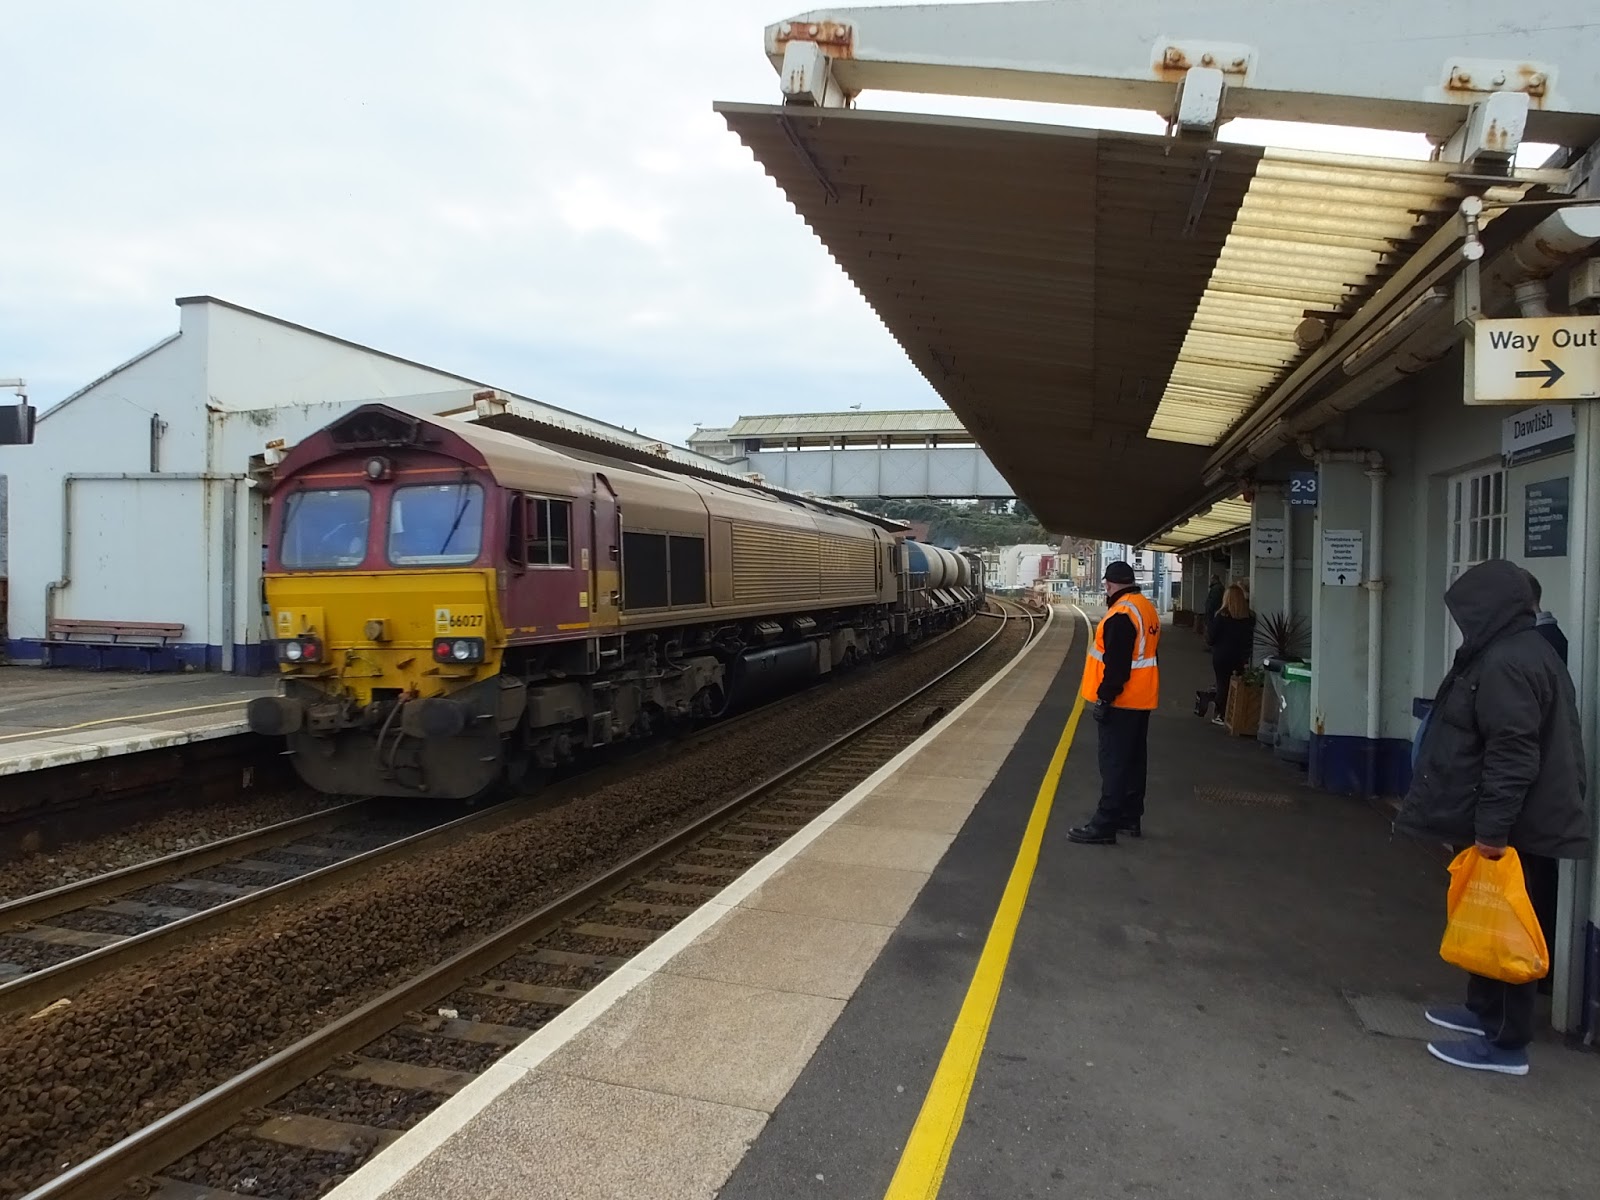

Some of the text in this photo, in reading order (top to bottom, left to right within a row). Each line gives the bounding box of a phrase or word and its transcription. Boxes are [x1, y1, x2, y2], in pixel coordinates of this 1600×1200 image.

[1488, 328, 1598, 353] Way Out
[1513, 408, 1553, 440] Dawlish
[1291, 479, 1317, 493] 2-3
[450, 614, 484, 628] 66027
